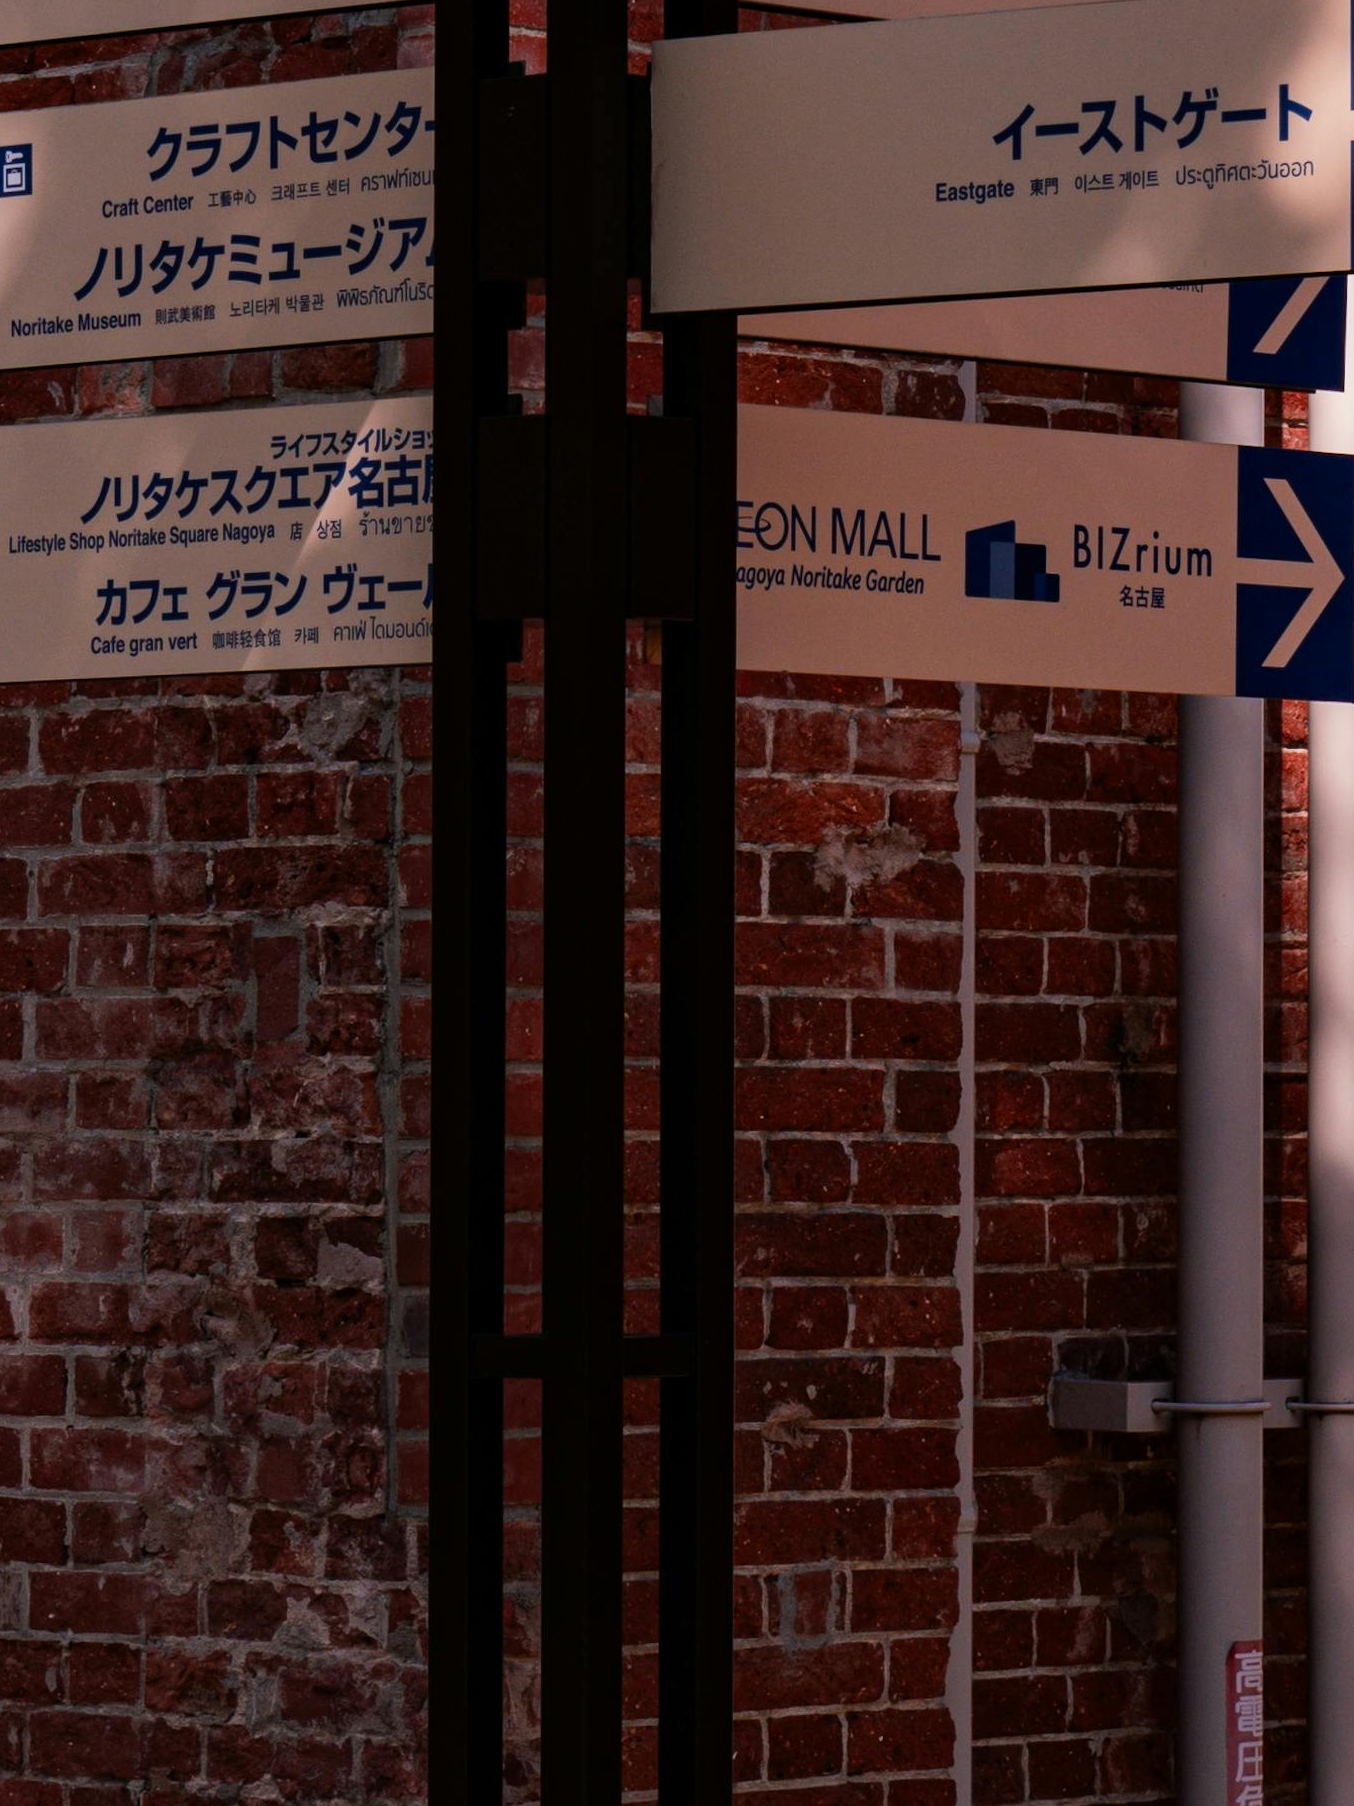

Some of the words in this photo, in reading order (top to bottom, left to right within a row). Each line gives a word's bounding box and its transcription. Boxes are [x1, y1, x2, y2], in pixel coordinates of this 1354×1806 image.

[992, 83, 1314, 161] イーストゲート
[270, 181, 322, 202] 크래프트
[326, 177, 351, 197] 센터
[935, 179, 1015, 205] Eastgate
[1029, 177, 1060, 197] 東門
[1074, 168, 1116, 192] 이스트
[1119, 165, 1160, 191] 게이트
[101, 195, 140, 218] Craft
[143, 192, 195, 214] Center
[74, 218, 435, 301] ノリタケミュージア
[155, 303, 216, 326] 則武美術館
[230, 293, 281, 318] 노리타케
[286, 291, 326, 315] 박물관
[10, 311, 74, 337] Noritake
[77, 303, 142, 329] Museum
[80, 454, 433, 525] ノリタケスクエア名古
[9, 533, 66, 556] Lifestyle
[69, 530, 105, 554] Shop
[109, 527, 166, 549] Noritake
[170, 525, 219, 549] Square
[222, 522, 275, 543] Nagoya
[290, 521, 303, 540] 店
[316, 519, 342, 539] 상점
[737, 500, 816, 553] EON
[832, 507, 941, 562] MALL
[1073, 524, 1213, 577] BIZrium
[737, 565, 785, 591] agoya
[791, 564, 861, 591] Noritake
[866, 569, 925, 595] Garden
[96, 579, 190, 626] カフェ
[206, 569, 308, 620] グラン
[323, 563, 433, 614] ヴェー
[1119, 585, 1166, 609] 名古屋
[91, 635, 126, 655] Cafe
[129, 635, 164, 656] gran
[168, 632, 198, 650] vert
[295, 626, 319, 644] 카페
